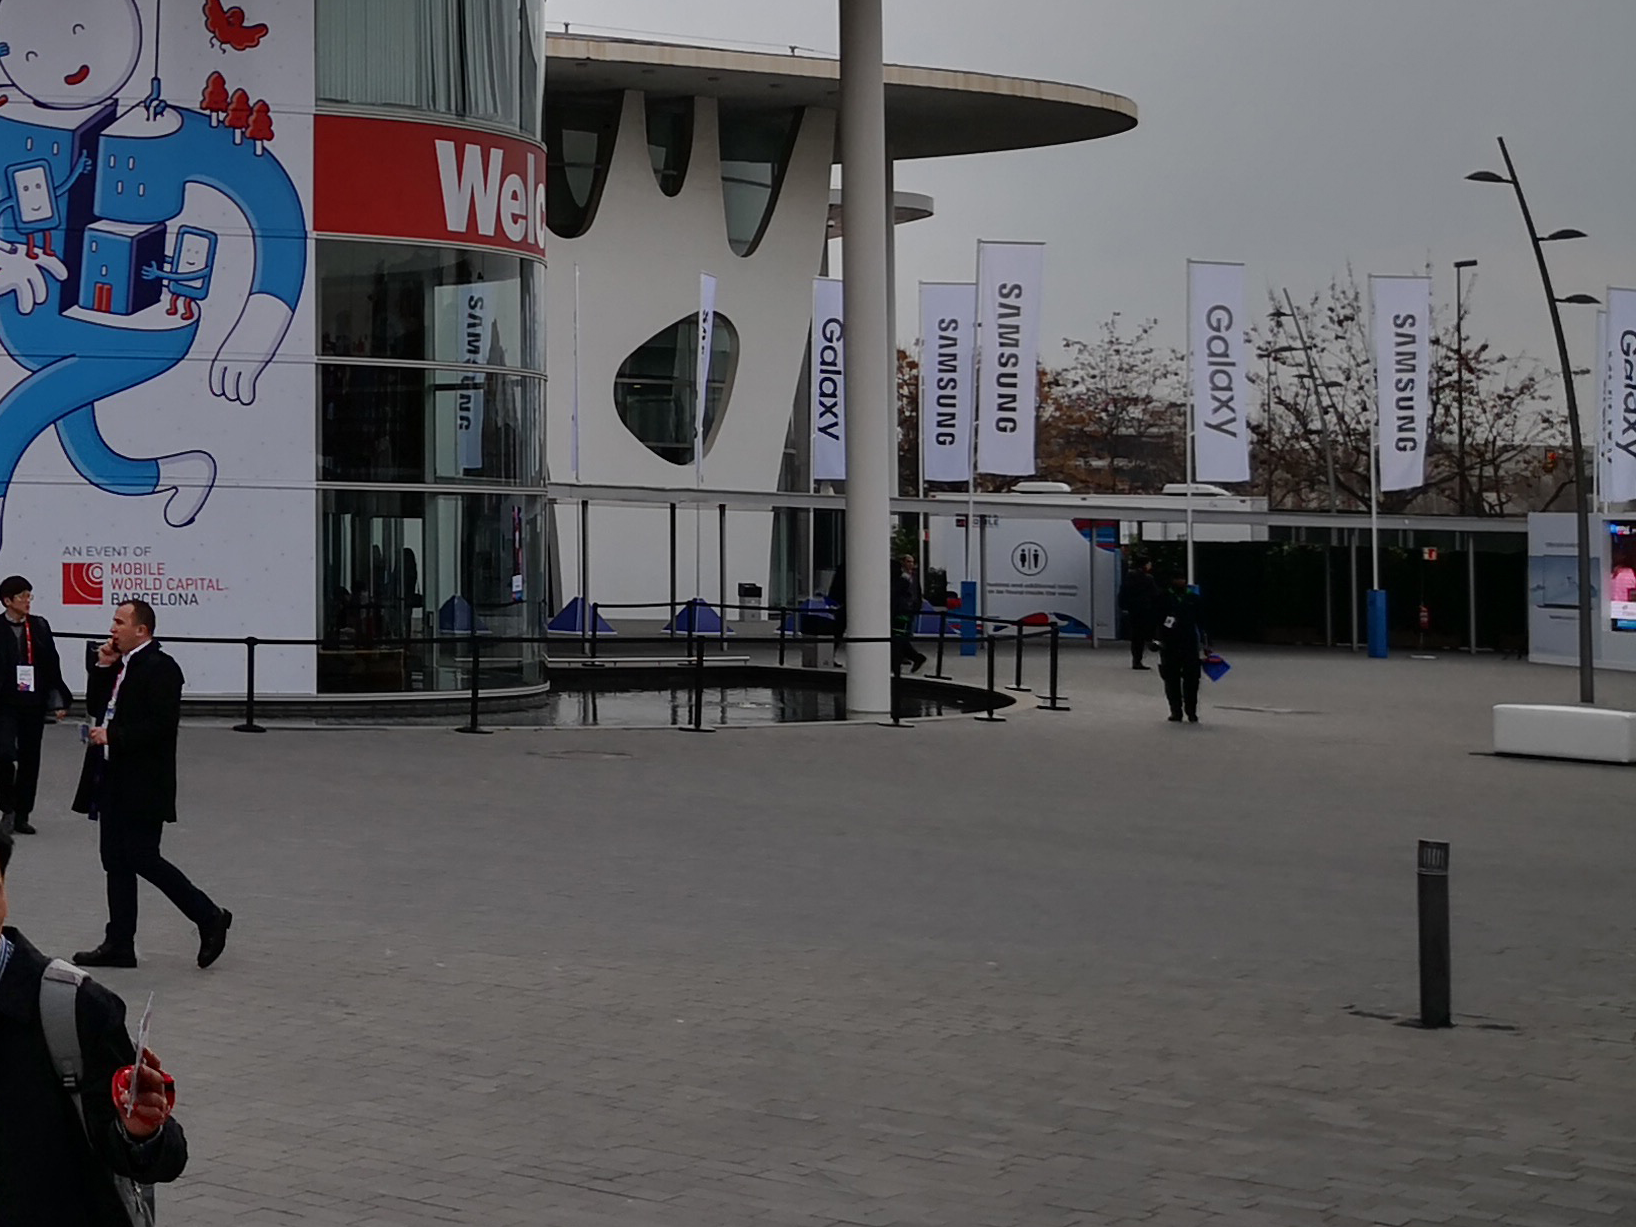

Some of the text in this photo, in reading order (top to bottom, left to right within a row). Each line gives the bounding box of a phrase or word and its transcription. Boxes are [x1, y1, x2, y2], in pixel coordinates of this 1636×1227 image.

[817, 317, 844, 441] Galaxy
[935, 318, 959, 447] SAMSUNG
[995, 283, 1022, 434] SAMSUNG
[1203, 304, 1238, 439] Galaxy
[1392, 313, 1418, 453] SAMSUNG
[63, 546, 152, 557] AN EVENT OF
[111, 562, 165, 575] MOBILE
[111, 578, 162, 591] WORLD
